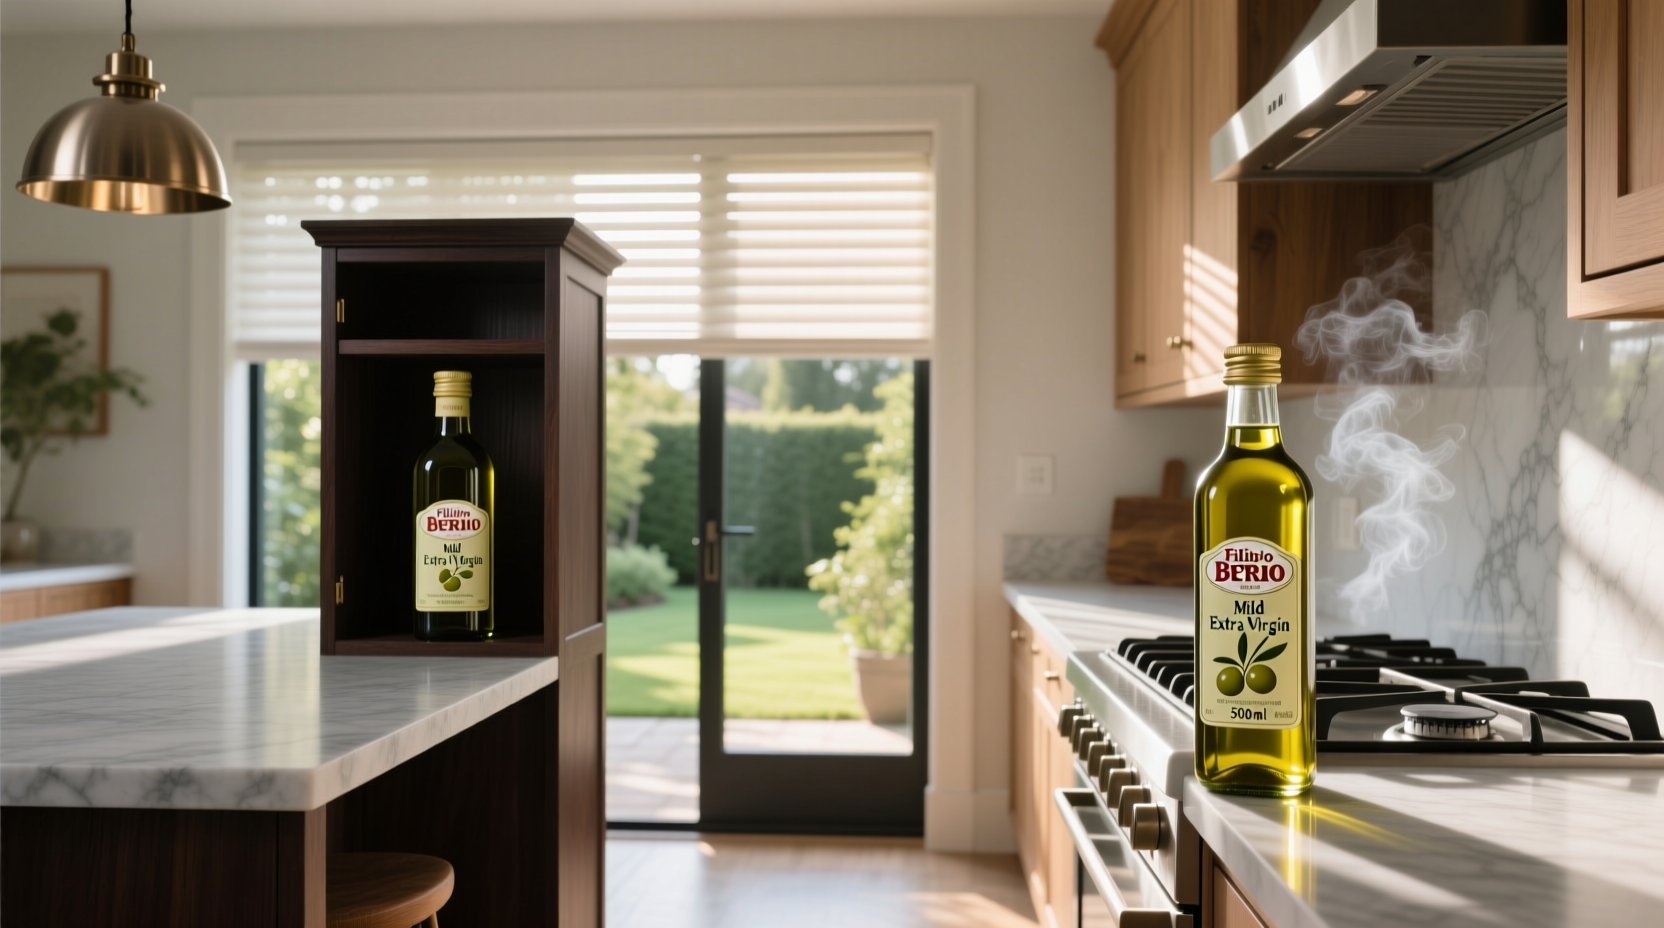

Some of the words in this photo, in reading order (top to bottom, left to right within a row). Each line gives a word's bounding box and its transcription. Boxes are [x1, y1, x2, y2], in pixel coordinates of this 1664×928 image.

[1215, 561, 1285, 582] BERIO
[1234, 600, 1264, 615] Mild
[1209, 615, 1244, 631] Extra
[1247, 616, 1290, 636] Virgin
